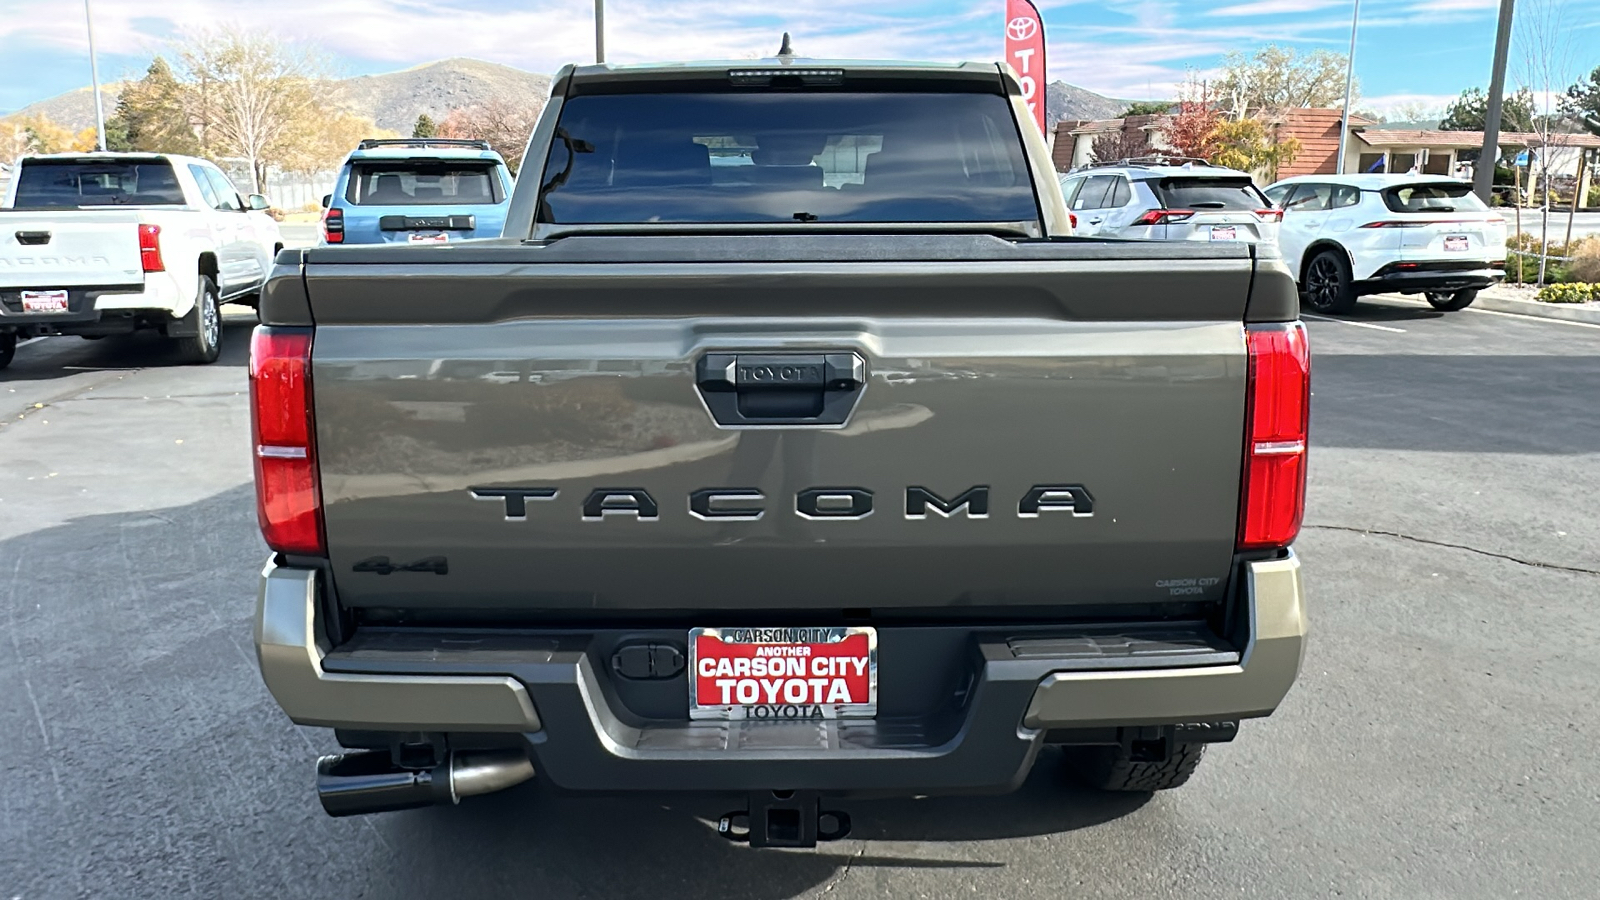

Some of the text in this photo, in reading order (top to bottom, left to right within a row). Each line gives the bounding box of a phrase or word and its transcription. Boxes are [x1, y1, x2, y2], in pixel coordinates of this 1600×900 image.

[1014, 48, 1036, 112] TO
[741, 367, 820, 381] TOYOTA
[467, 484, 1096, 521] TACOMA
[1155, 577, 1219, 587] CARSON CITY
[1169, 587, 1203, 595] TOYOTA
[734, 629, 832, 643] CARSON CITY
[756, 646, 811, 656] ANOTHER
[699, 656, 869, 677] CARSON CITY
[716, 678, 852, 703] TOYOTA
[743, 705, 824, 718] TOYOTA
